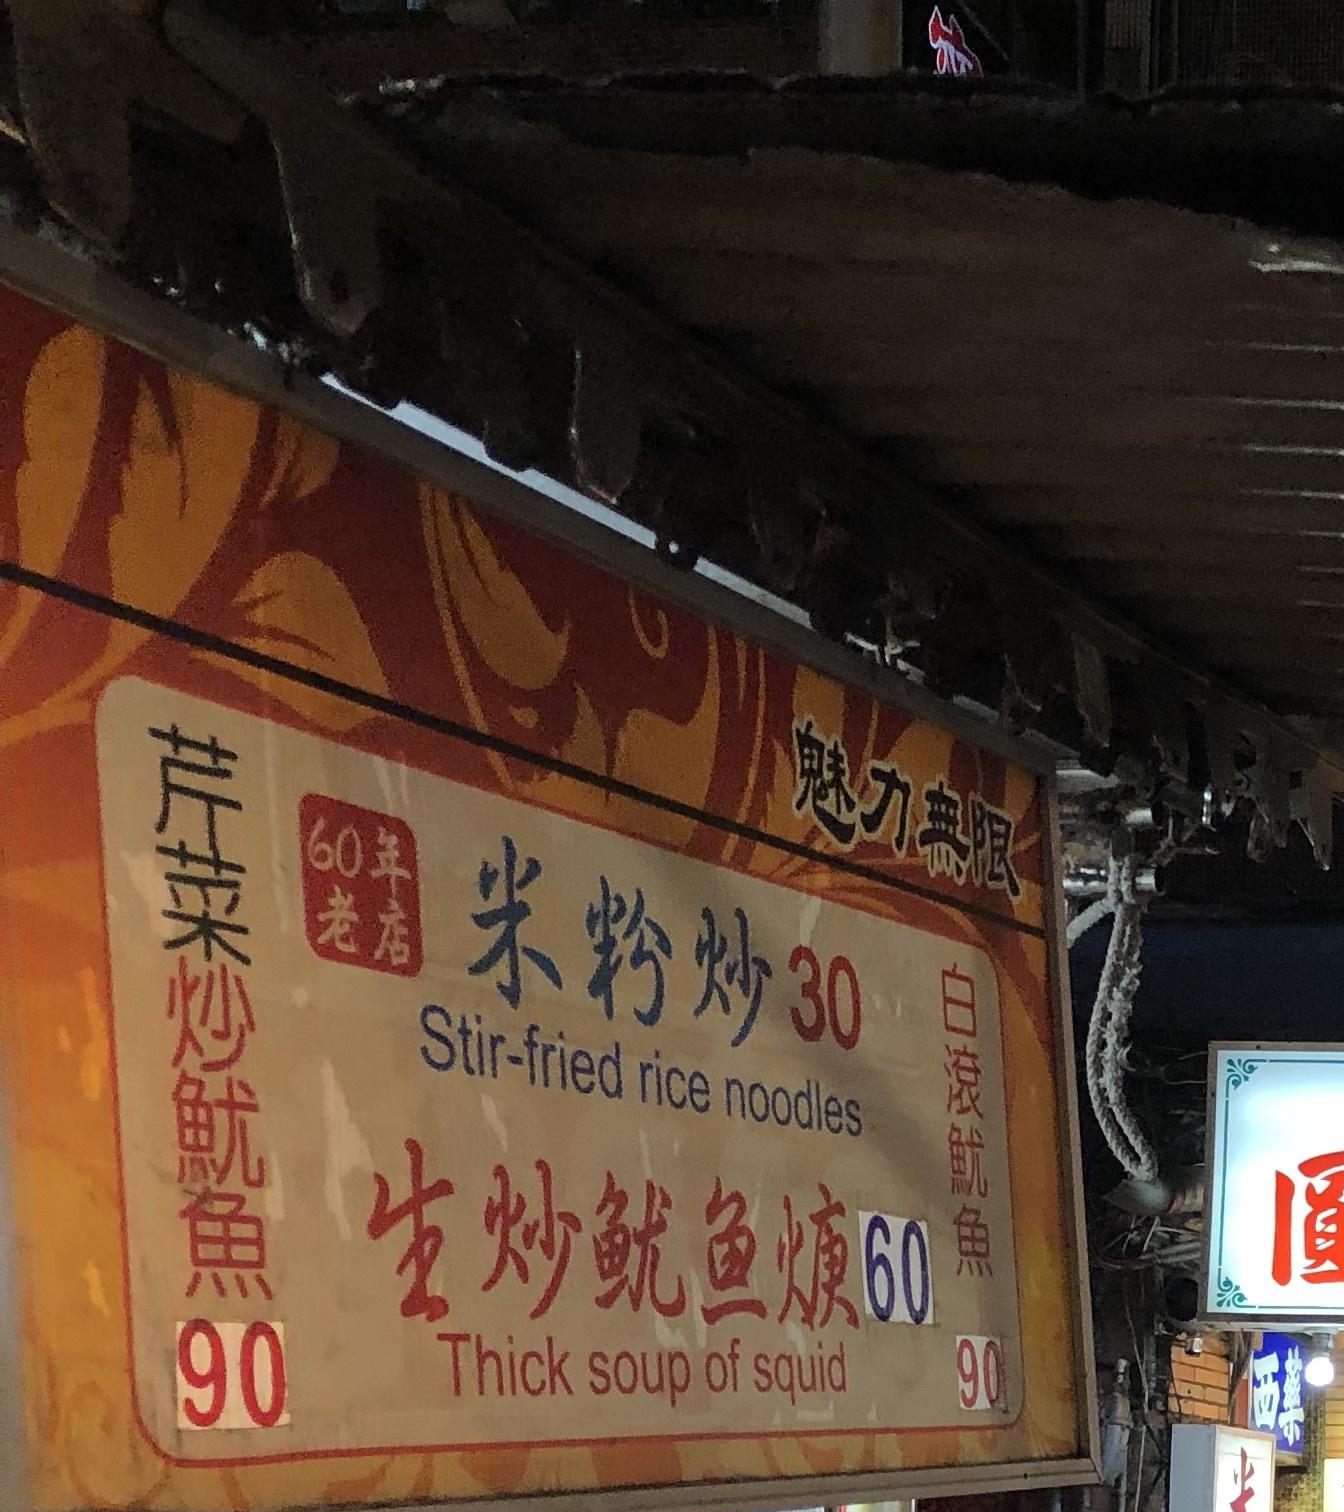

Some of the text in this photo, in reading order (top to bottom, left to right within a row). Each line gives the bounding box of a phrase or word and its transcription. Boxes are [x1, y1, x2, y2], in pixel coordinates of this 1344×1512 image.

[308, 816, 412, 898] 60年
[794, 718, 1020, 898] 魅力無限
[317, 884, 411, 965] 老店
[468, 838, 861, 1050] 米粉炒 30
[149, 723, 274, 1302] 芹菜炒魷魚
[420, 1005, 863, 1137] Stir-fried rice noodles
[865, 1215, 930, 1323] 60
[178, 1320, 285, 1428] 90
[438, 1333, 847, 1406] Thick soup of squid
[956, 1338, 1001, 1409] 90
